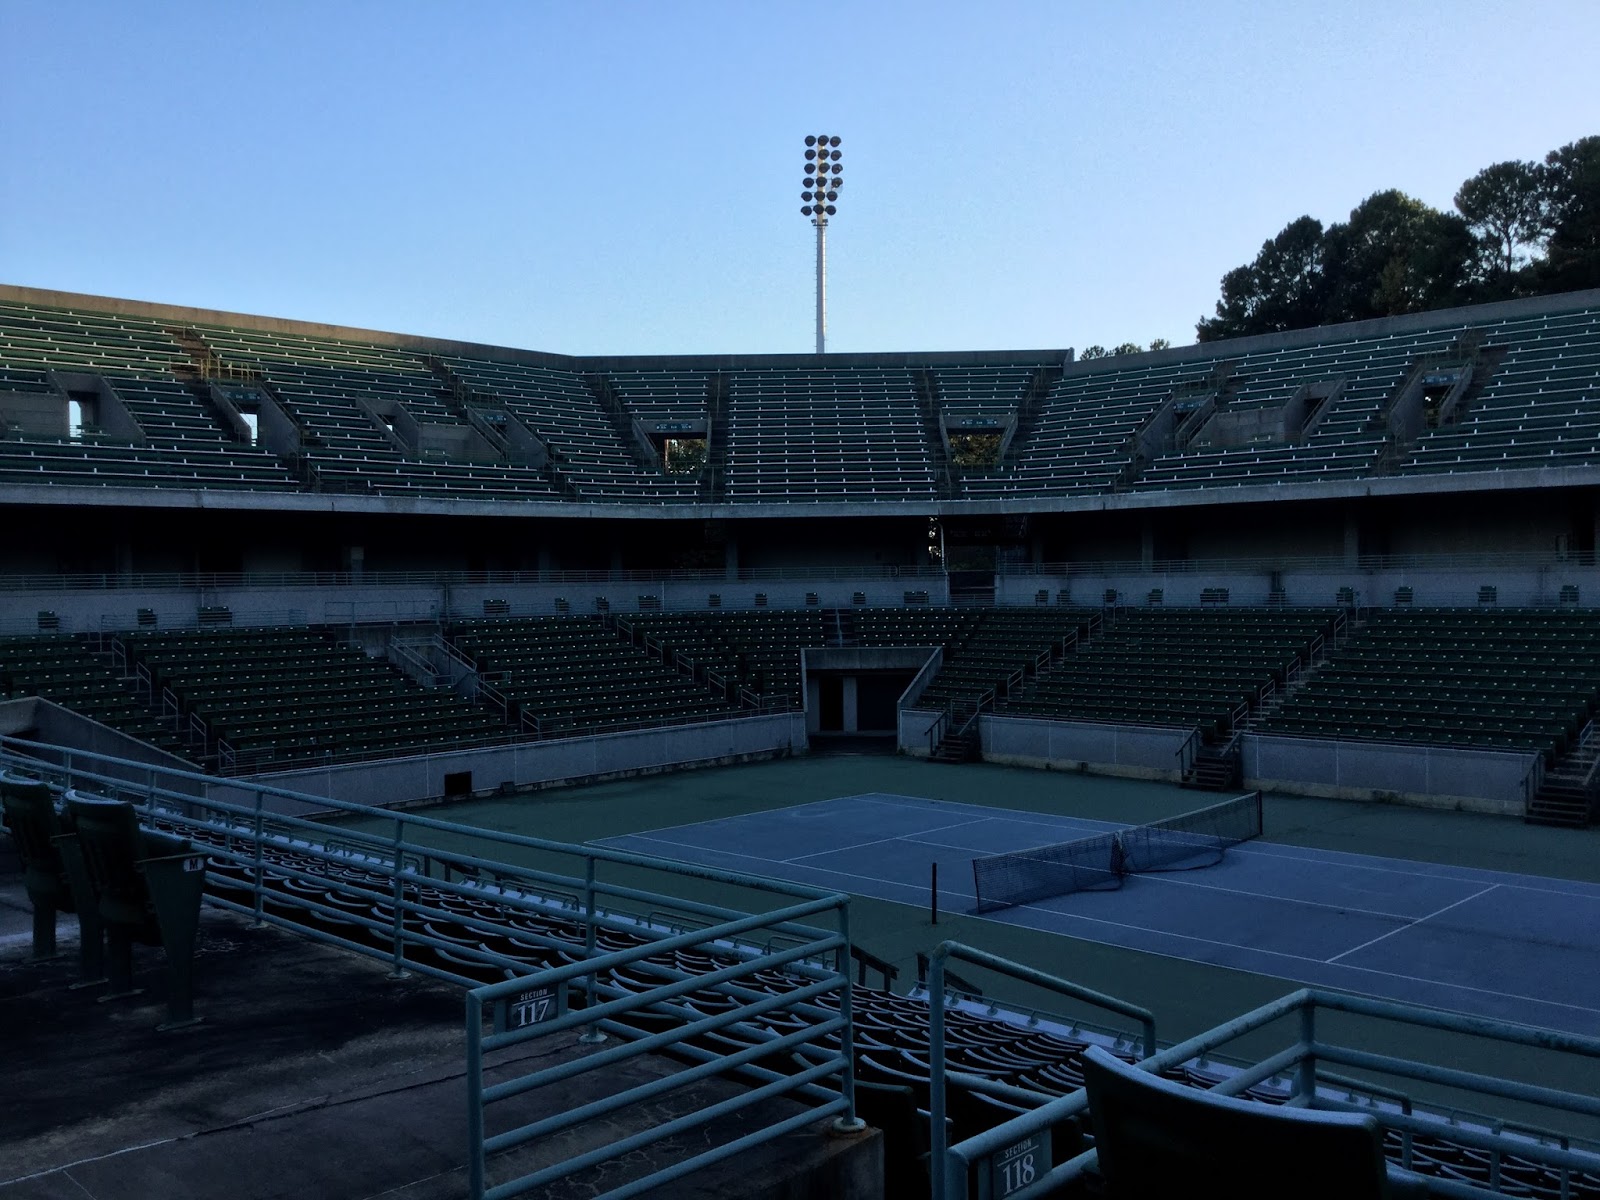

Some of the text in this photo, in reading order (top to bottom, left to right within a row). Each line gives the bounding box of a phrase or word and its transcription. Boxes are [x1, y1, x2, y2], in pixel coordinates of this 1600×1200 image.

[520, 988, 548, 1001] SECTION
[517, 999, 550, 1027] 117
[1004, 1138, 1032, 1158] SECTION
[1002, 1154, 1035, 1195] 118
